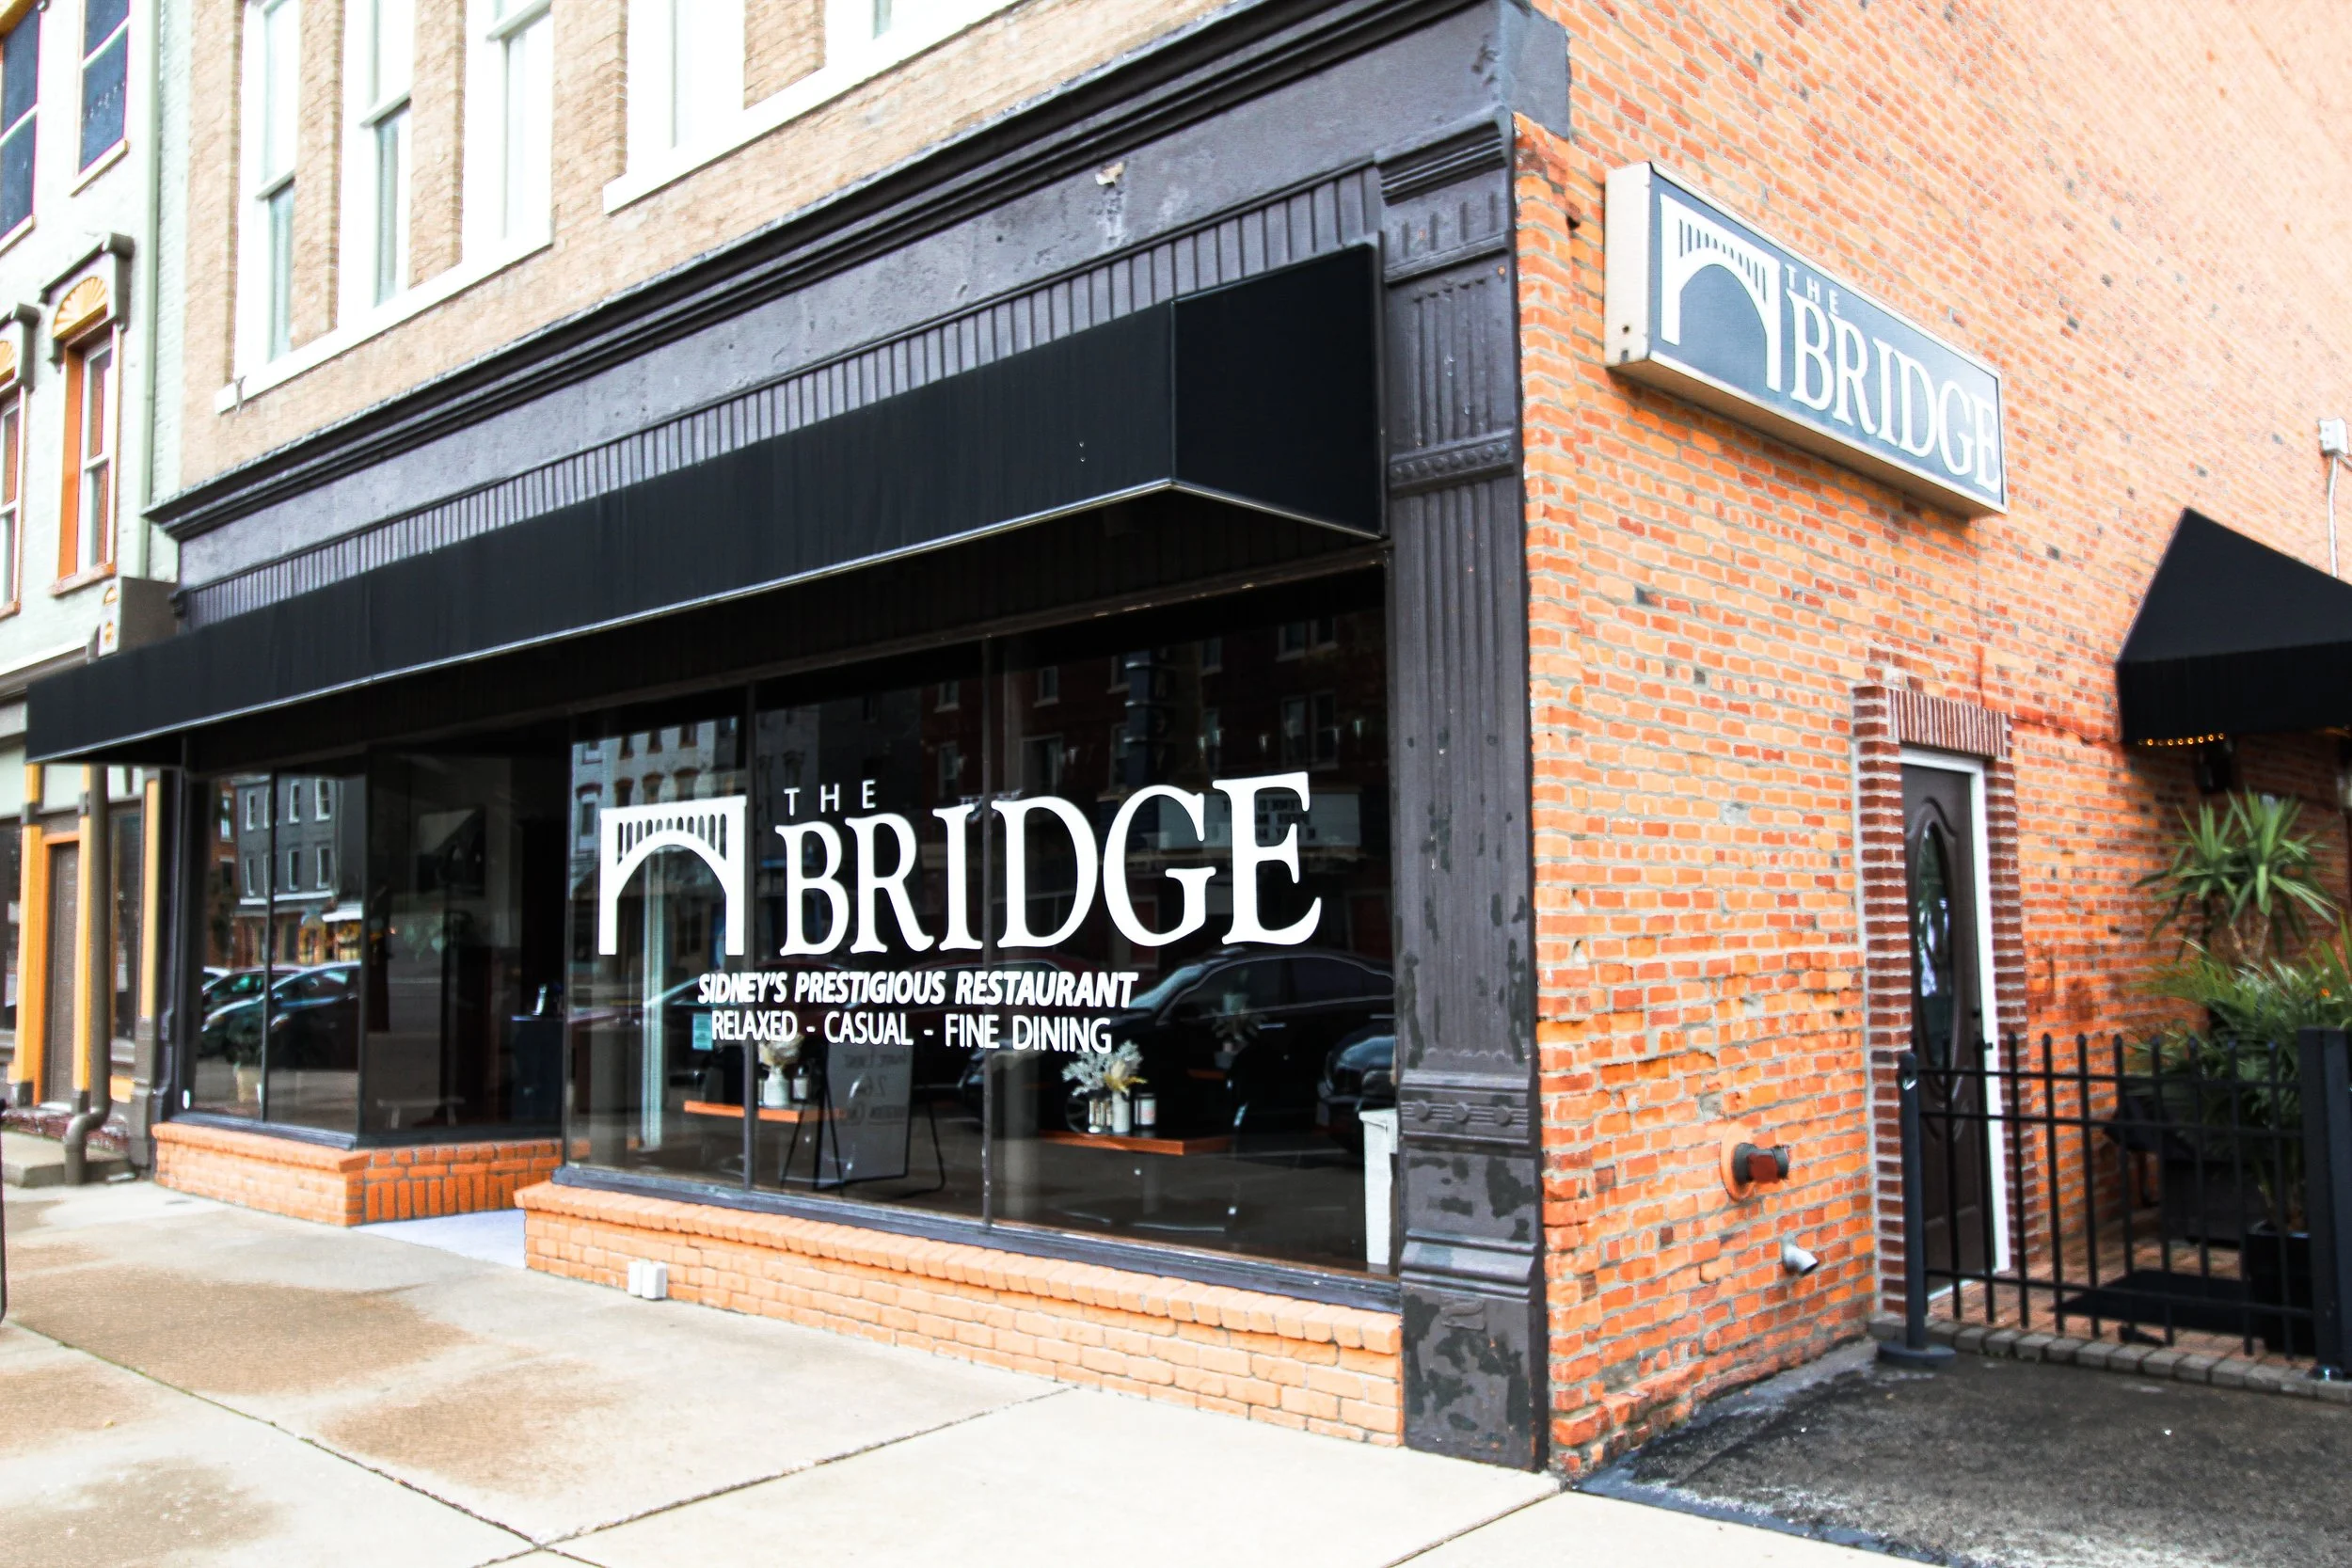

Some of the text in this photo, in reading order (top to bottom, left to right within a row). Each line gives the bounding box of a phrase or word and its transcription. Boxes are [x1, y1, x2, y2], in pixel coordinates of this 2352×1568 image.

[1784, 262, 1839, 316] THE
[1785, 287, 2002, 494] BRIDGE
[784, 780, 876, 816] THE
[774, 771, 1322, 957] BRIDGE
[697, 970, 1139, 1008] SIDNEY'S PRESTIGIOUS RESTAURANT
[711, 1009, 799, 1042] RELAXED
[824, 1010, 914, 1046] CASUAL
[945, 1013, 1000, 1049] FINE
[1011, 1014, 1112, 1054] DINING
